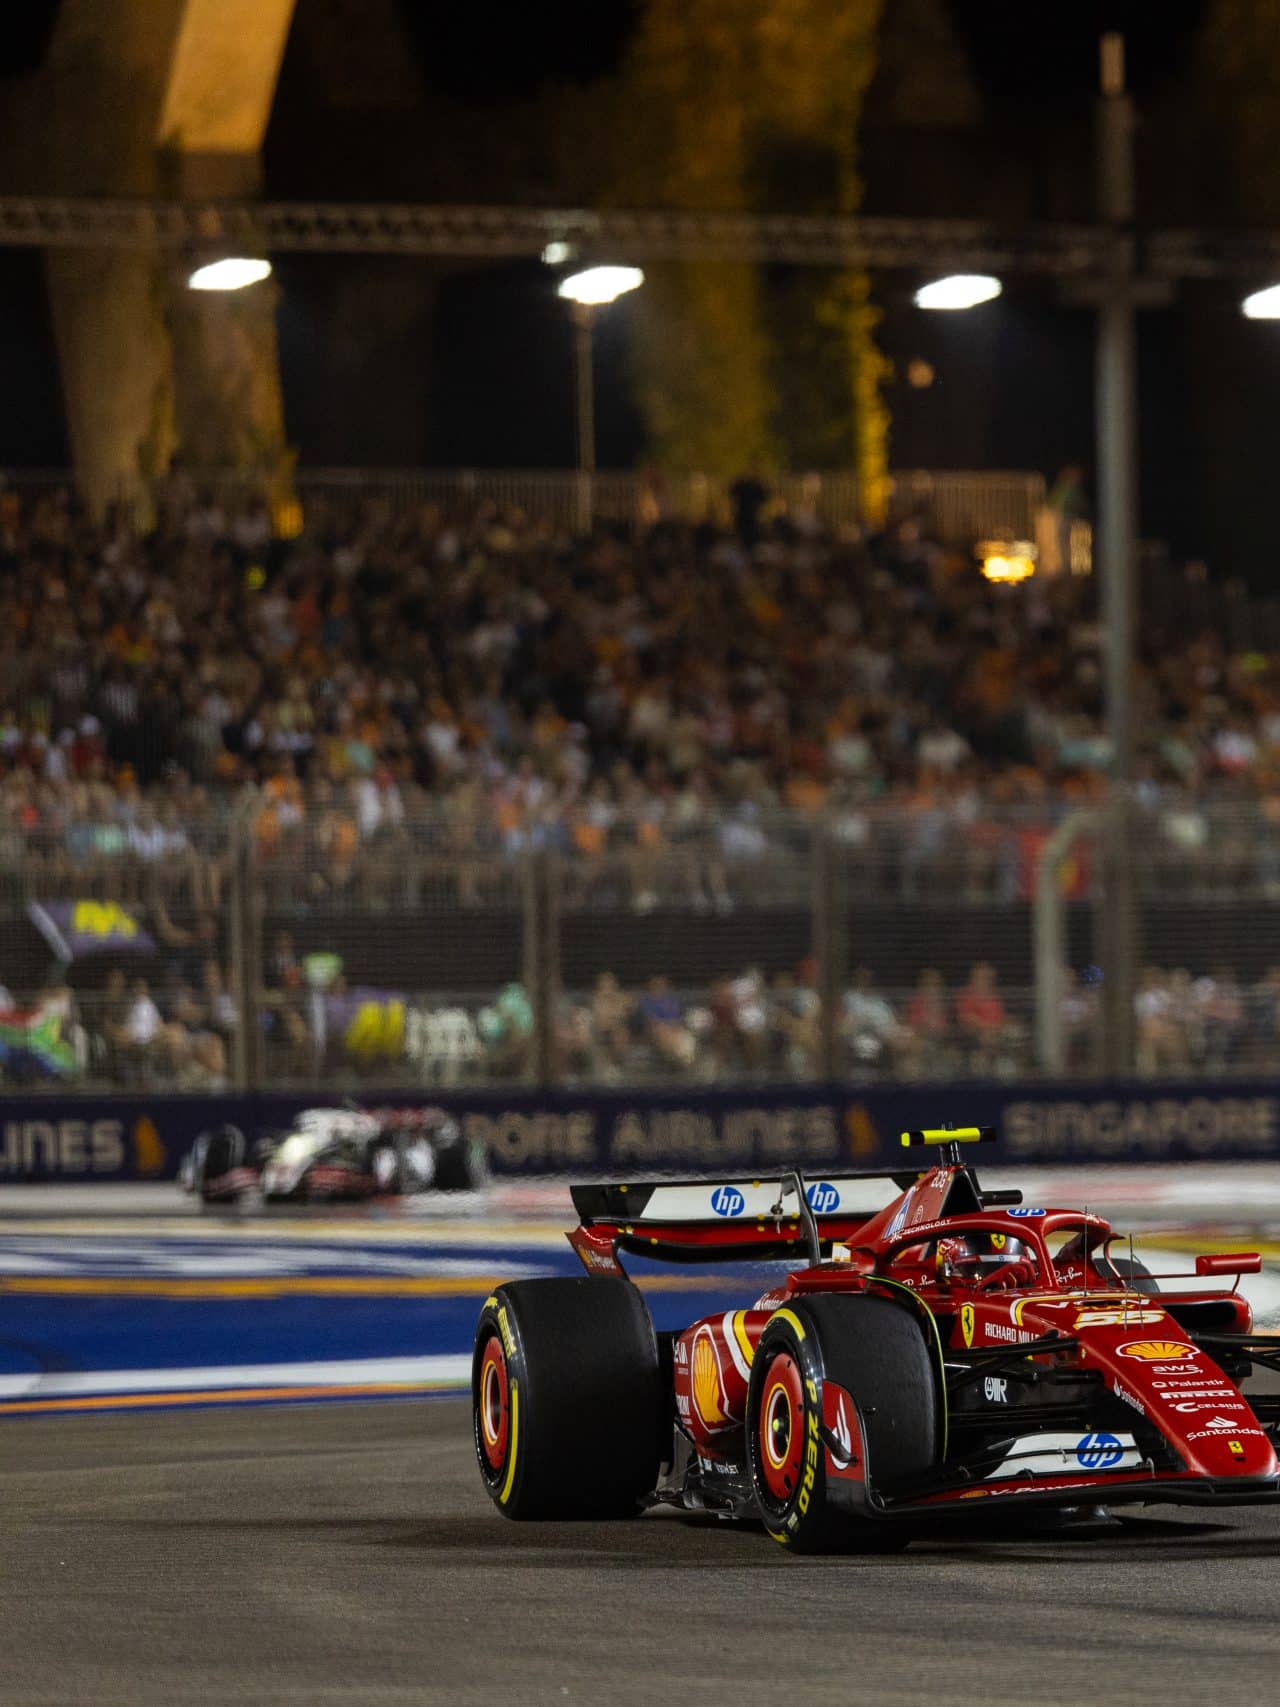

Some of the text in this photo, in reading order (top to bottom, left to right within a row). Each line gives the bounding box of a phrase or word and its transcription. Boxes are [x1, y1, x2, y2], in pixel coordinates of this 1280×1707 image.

[611, 1108, 840, 1163] AIRLINES
[1002, 1101, 1280, 1156] SINGAPORE
[0, 1119, 125, 1172] INES
[716, 1187, 741, 1216] hp
[811, 1183, 836, 1212] hp
[985, 1322, 1016, 1342] RICHARD
[1073, 1310, 1168, 1330] 55
[1152, 1364, 1201, 1374] aws
[1168, 1379, 1225, 1388] Palantir
[799, 1379, 819, 1516] P ZERO
[1186, 1427, 1265, 1441] Santander
[1081, 1433, 1120, 1468] hp
